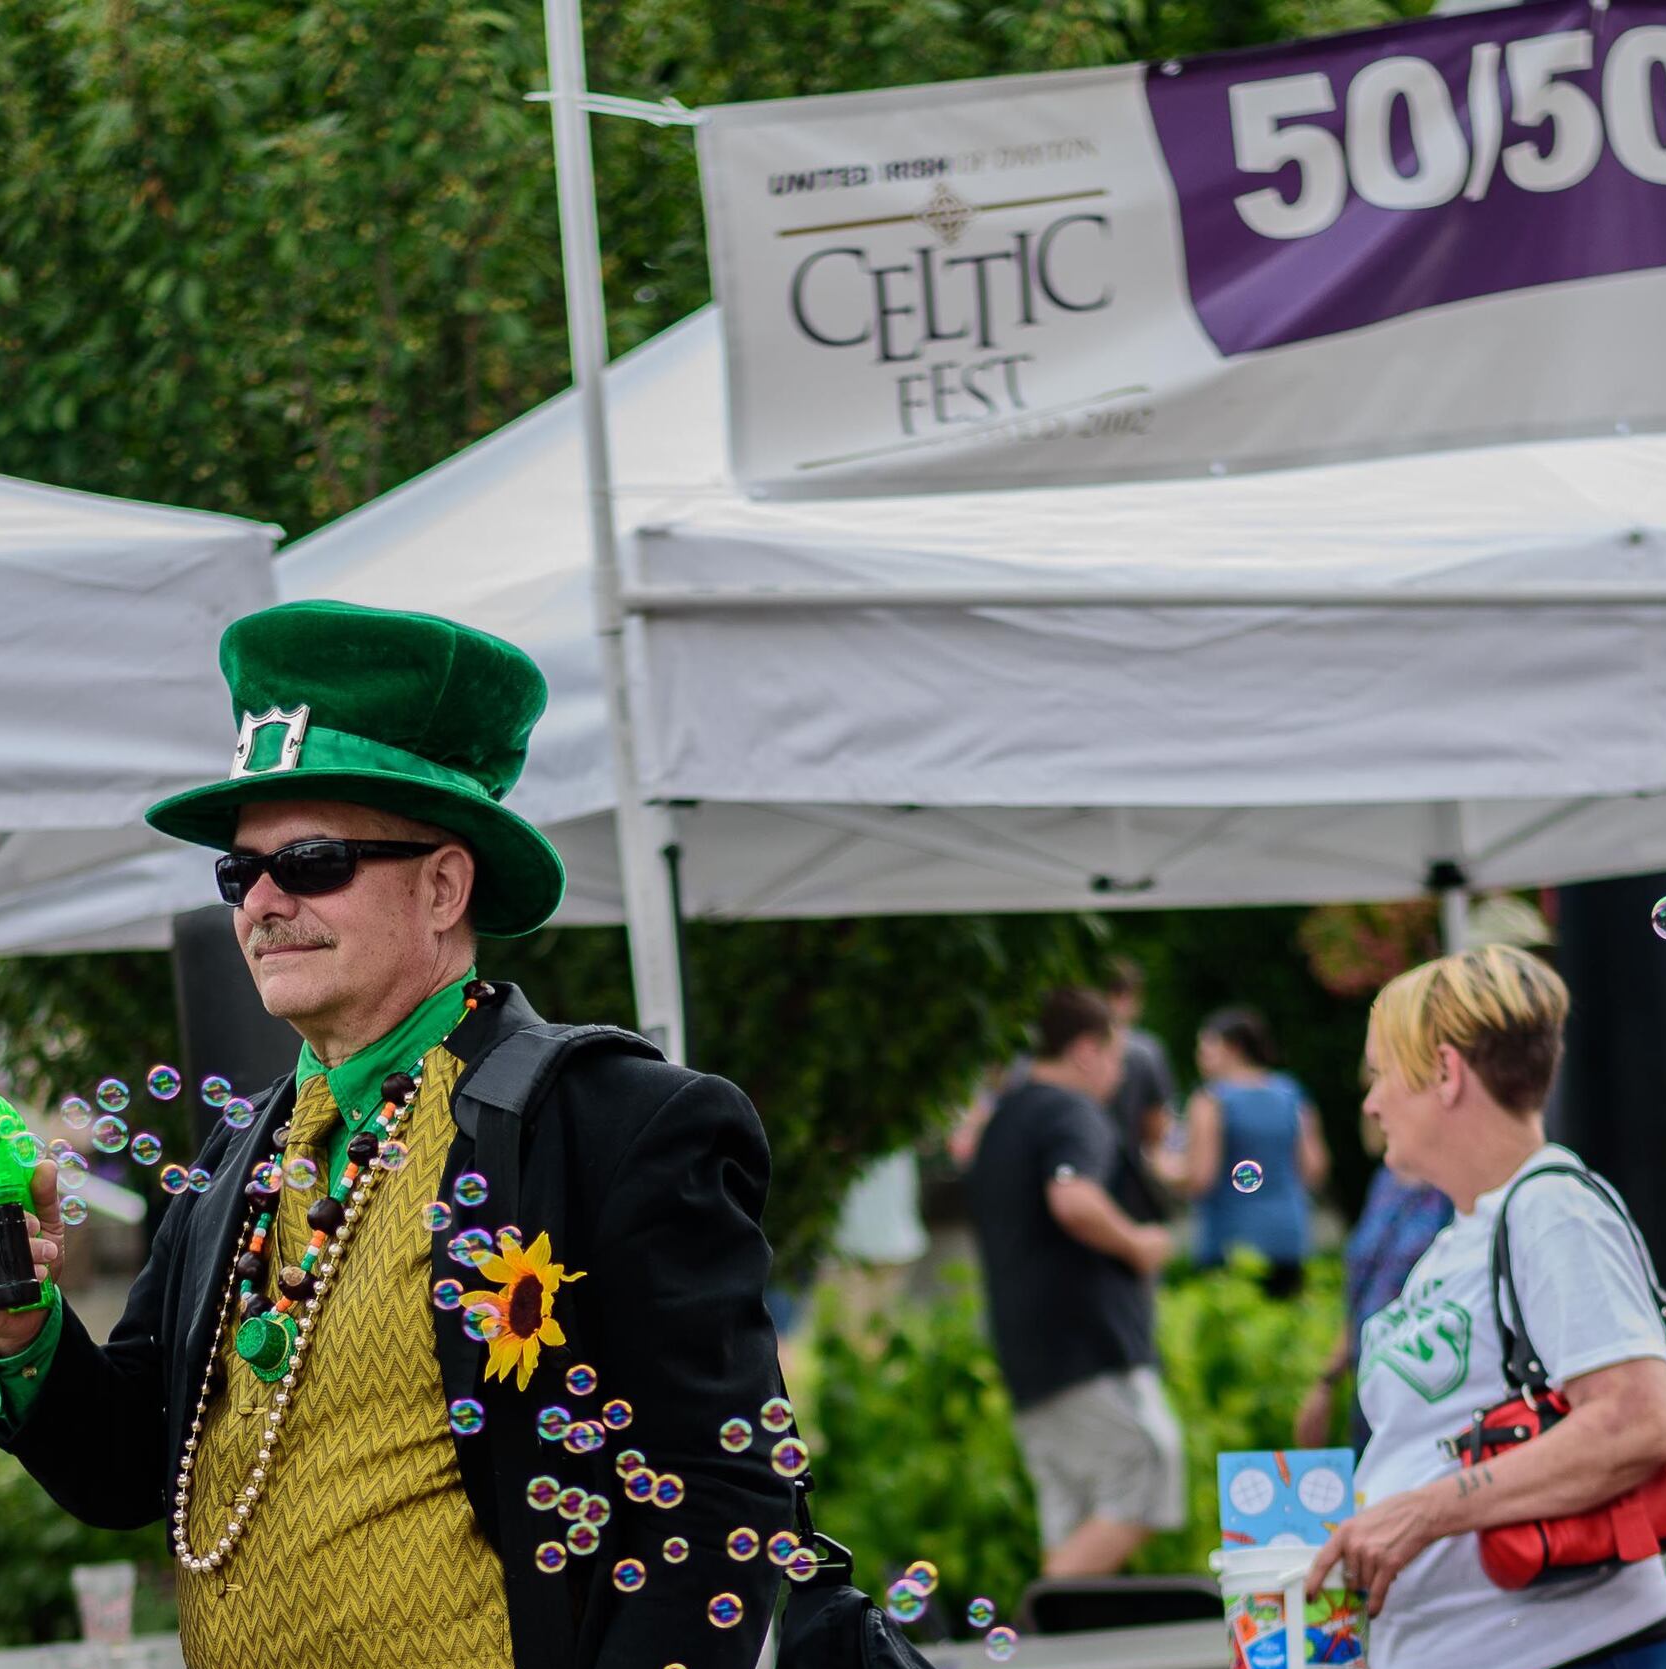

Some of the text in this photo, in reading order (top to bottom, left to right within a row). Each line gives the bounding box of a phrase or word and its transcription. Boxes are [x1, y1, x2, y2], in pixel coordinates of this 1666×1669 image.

[767, 166, 871, 196] UNITED
[879, 156, 949, 182] IRISH
[790, 214, 1115, 363] CELTIC
[896, 353, 1035, 436] FEST
